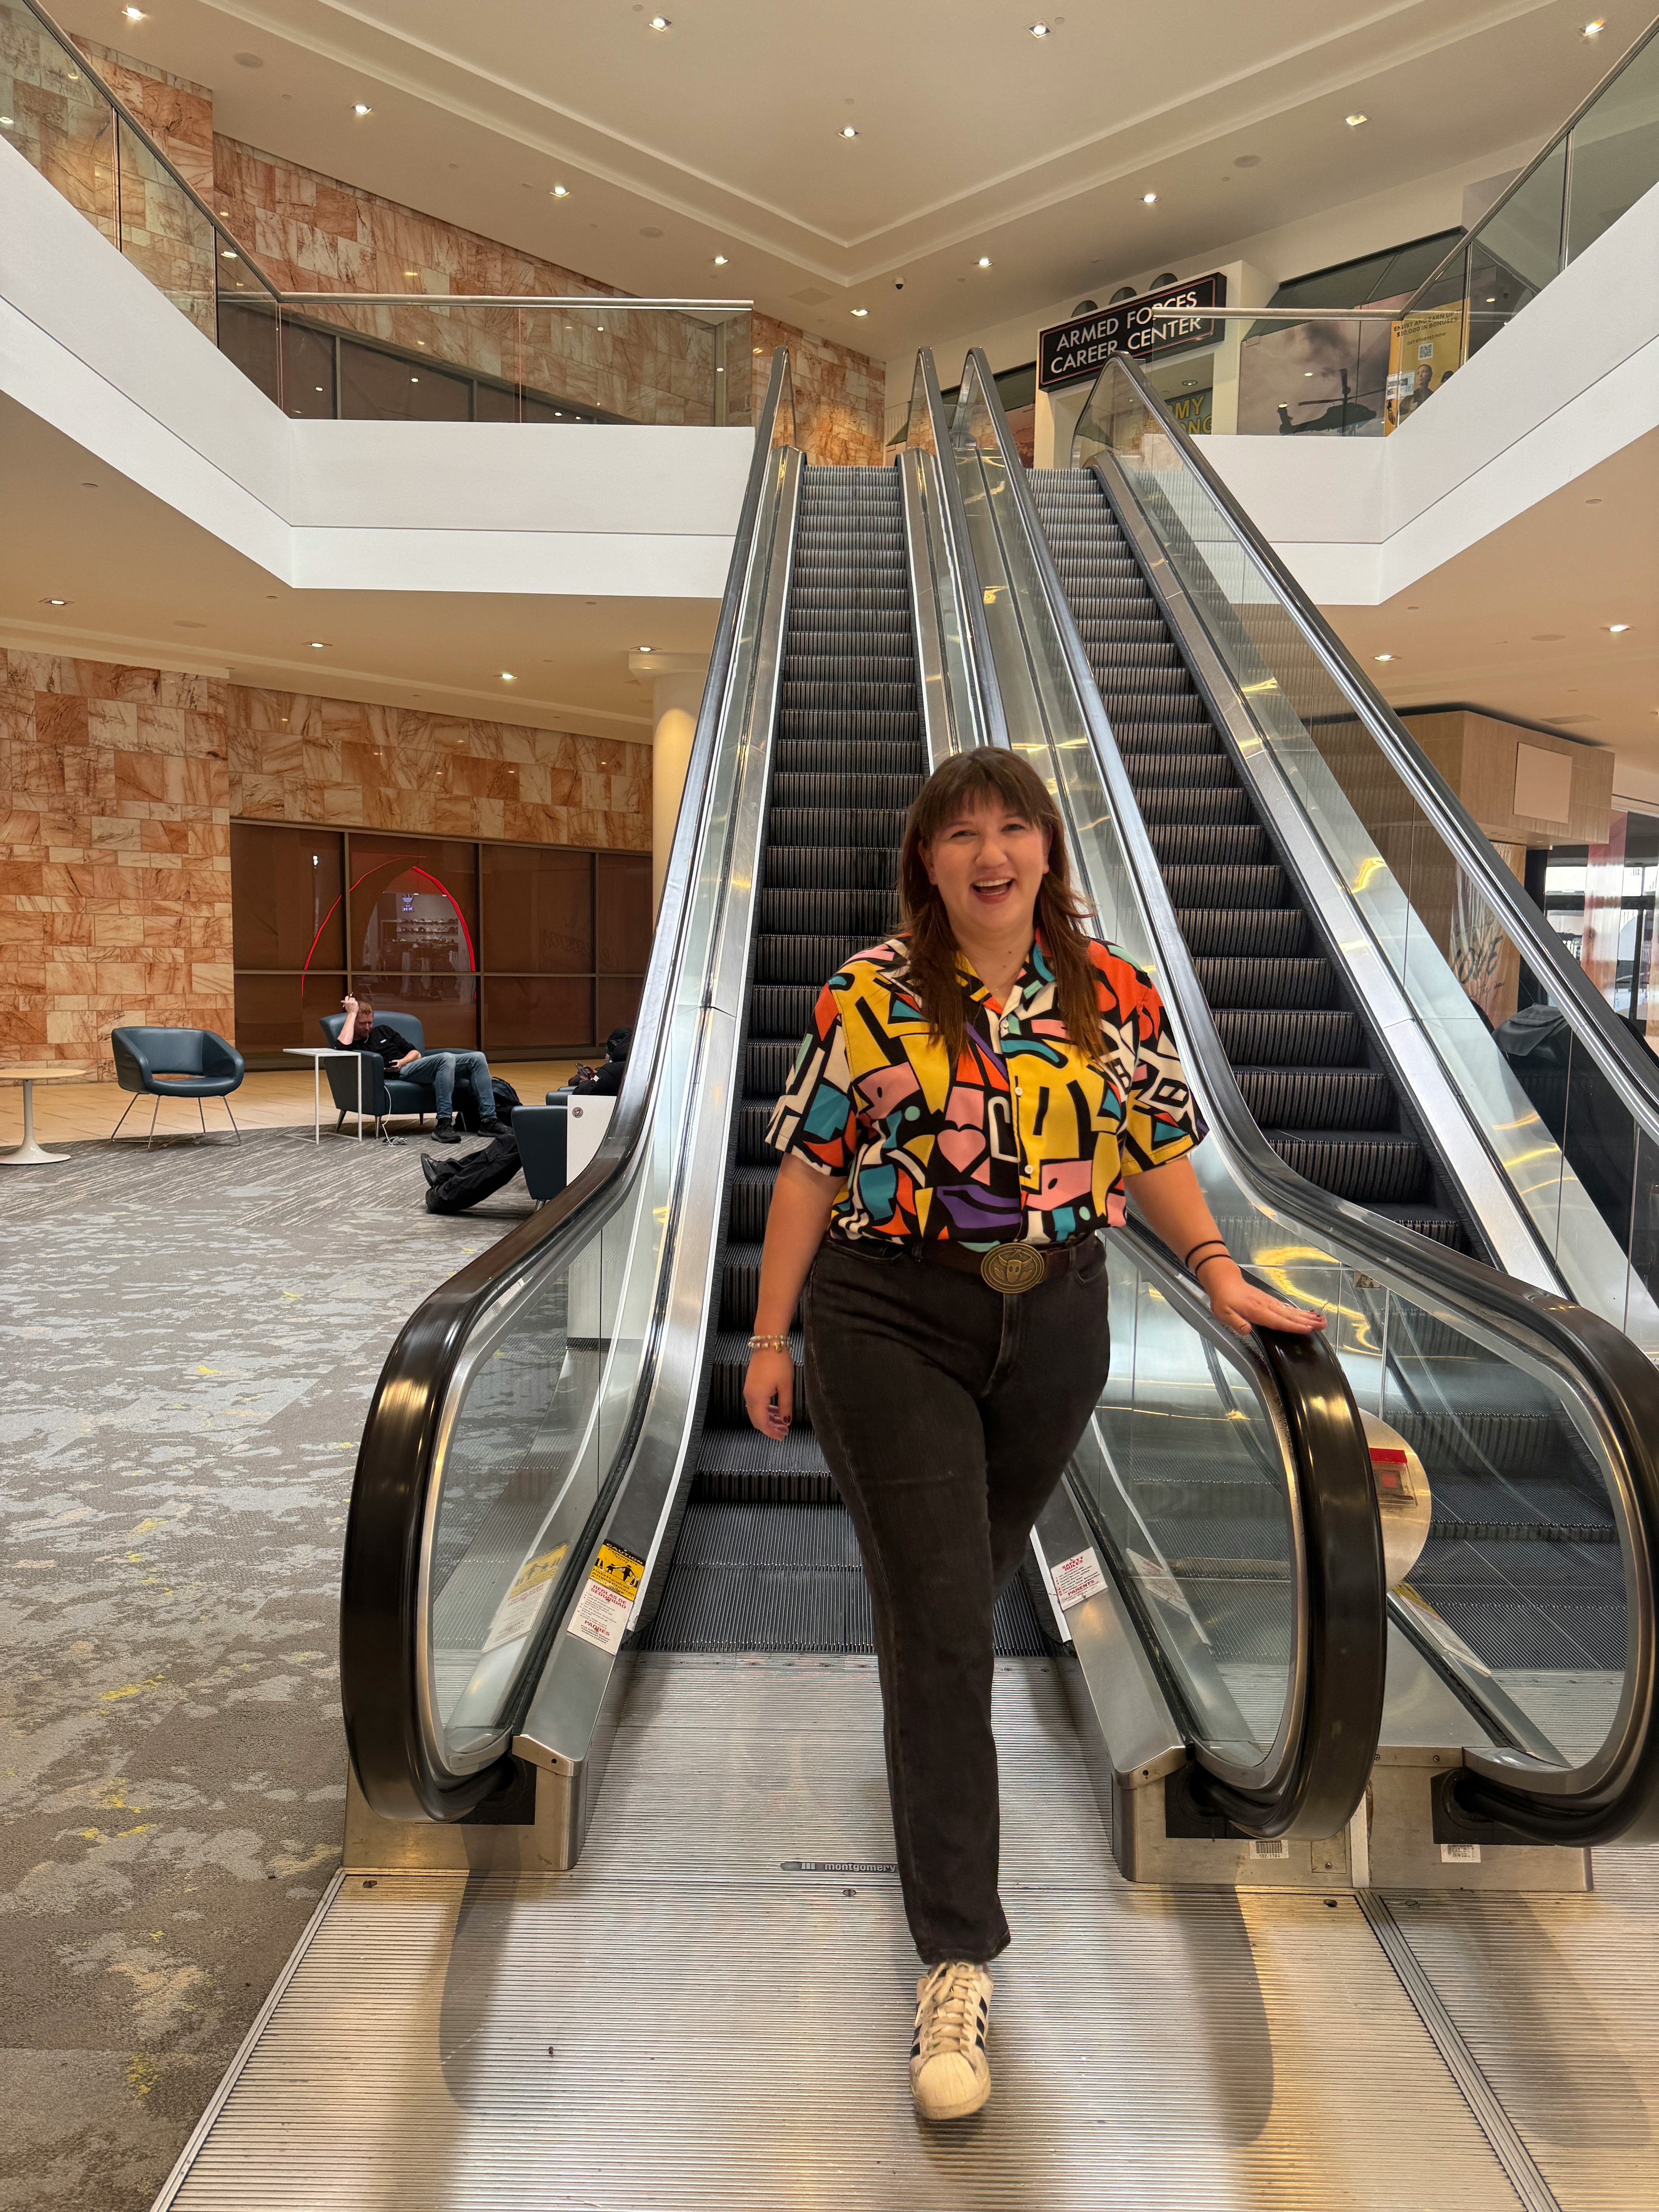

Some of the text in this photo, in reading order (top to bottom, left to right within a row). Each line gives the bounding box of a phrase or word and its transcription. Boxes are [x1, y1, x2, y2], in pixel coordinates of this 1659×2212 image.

[1428, 313, 1444, 322] EARN
[1429, 317, 1458, 328] BONUSES
[1056, 318, 1119, 352] ARMED
[1051, 318, 1202, 374] CAREER CENTER
[606, 1543, 643, 1565] CAUTION
[591, 1588, 626, 1609] SEGURIDAD
[593, 1585, 617, 1599] REGLAS
[584, 1620, 610, 1636] PADRES
[824, 1863, 896, 1872] montgomery
